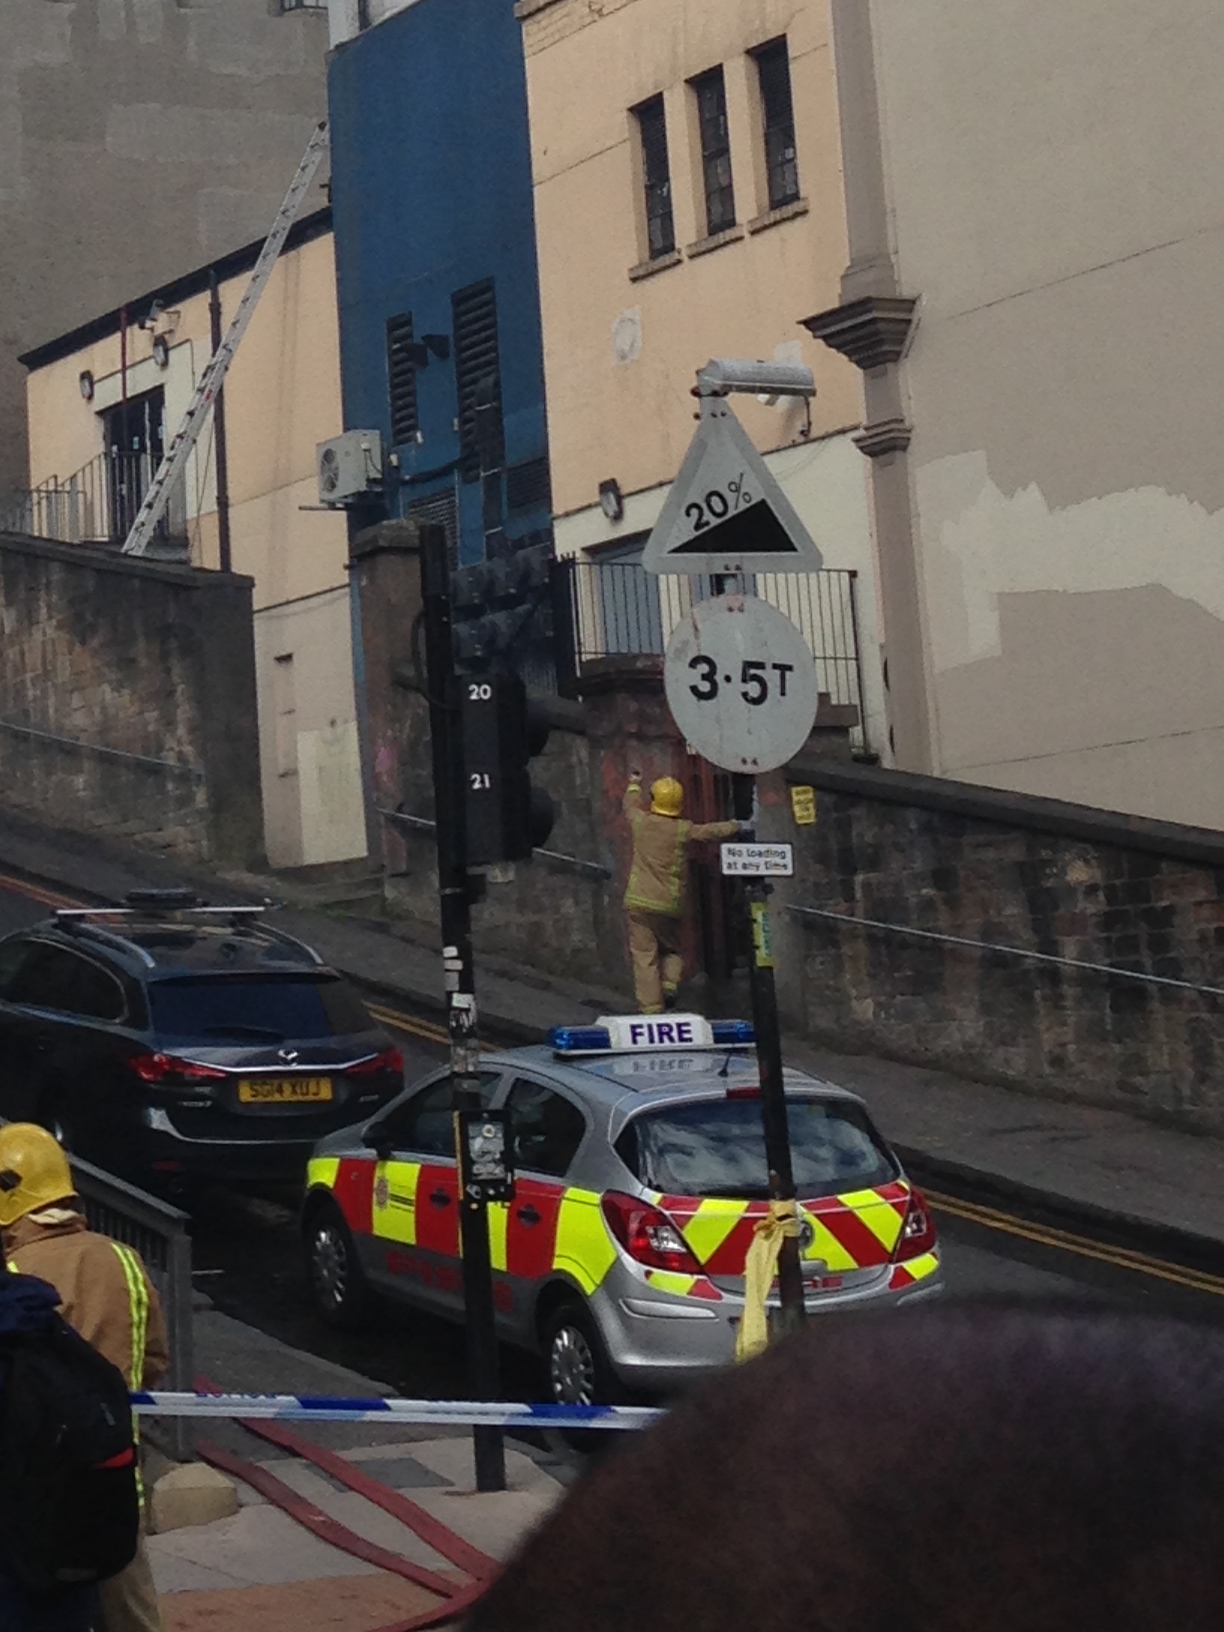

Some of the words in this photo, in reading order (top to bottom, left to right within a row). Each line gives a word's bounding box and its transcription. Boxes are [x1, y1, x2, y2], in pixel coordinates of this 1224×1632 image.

[684, 472, 753, 532] 20%
[468, 684, 492, 700] 20
[470, 773, 490, 789] 21
[727, 847, 743, 858] No
[746, 847, 786, 860] loading
[726, 860, 739, 870] at
[741, 861, 761, 872] any
[629, 1021, 693, 1045] FIRE
